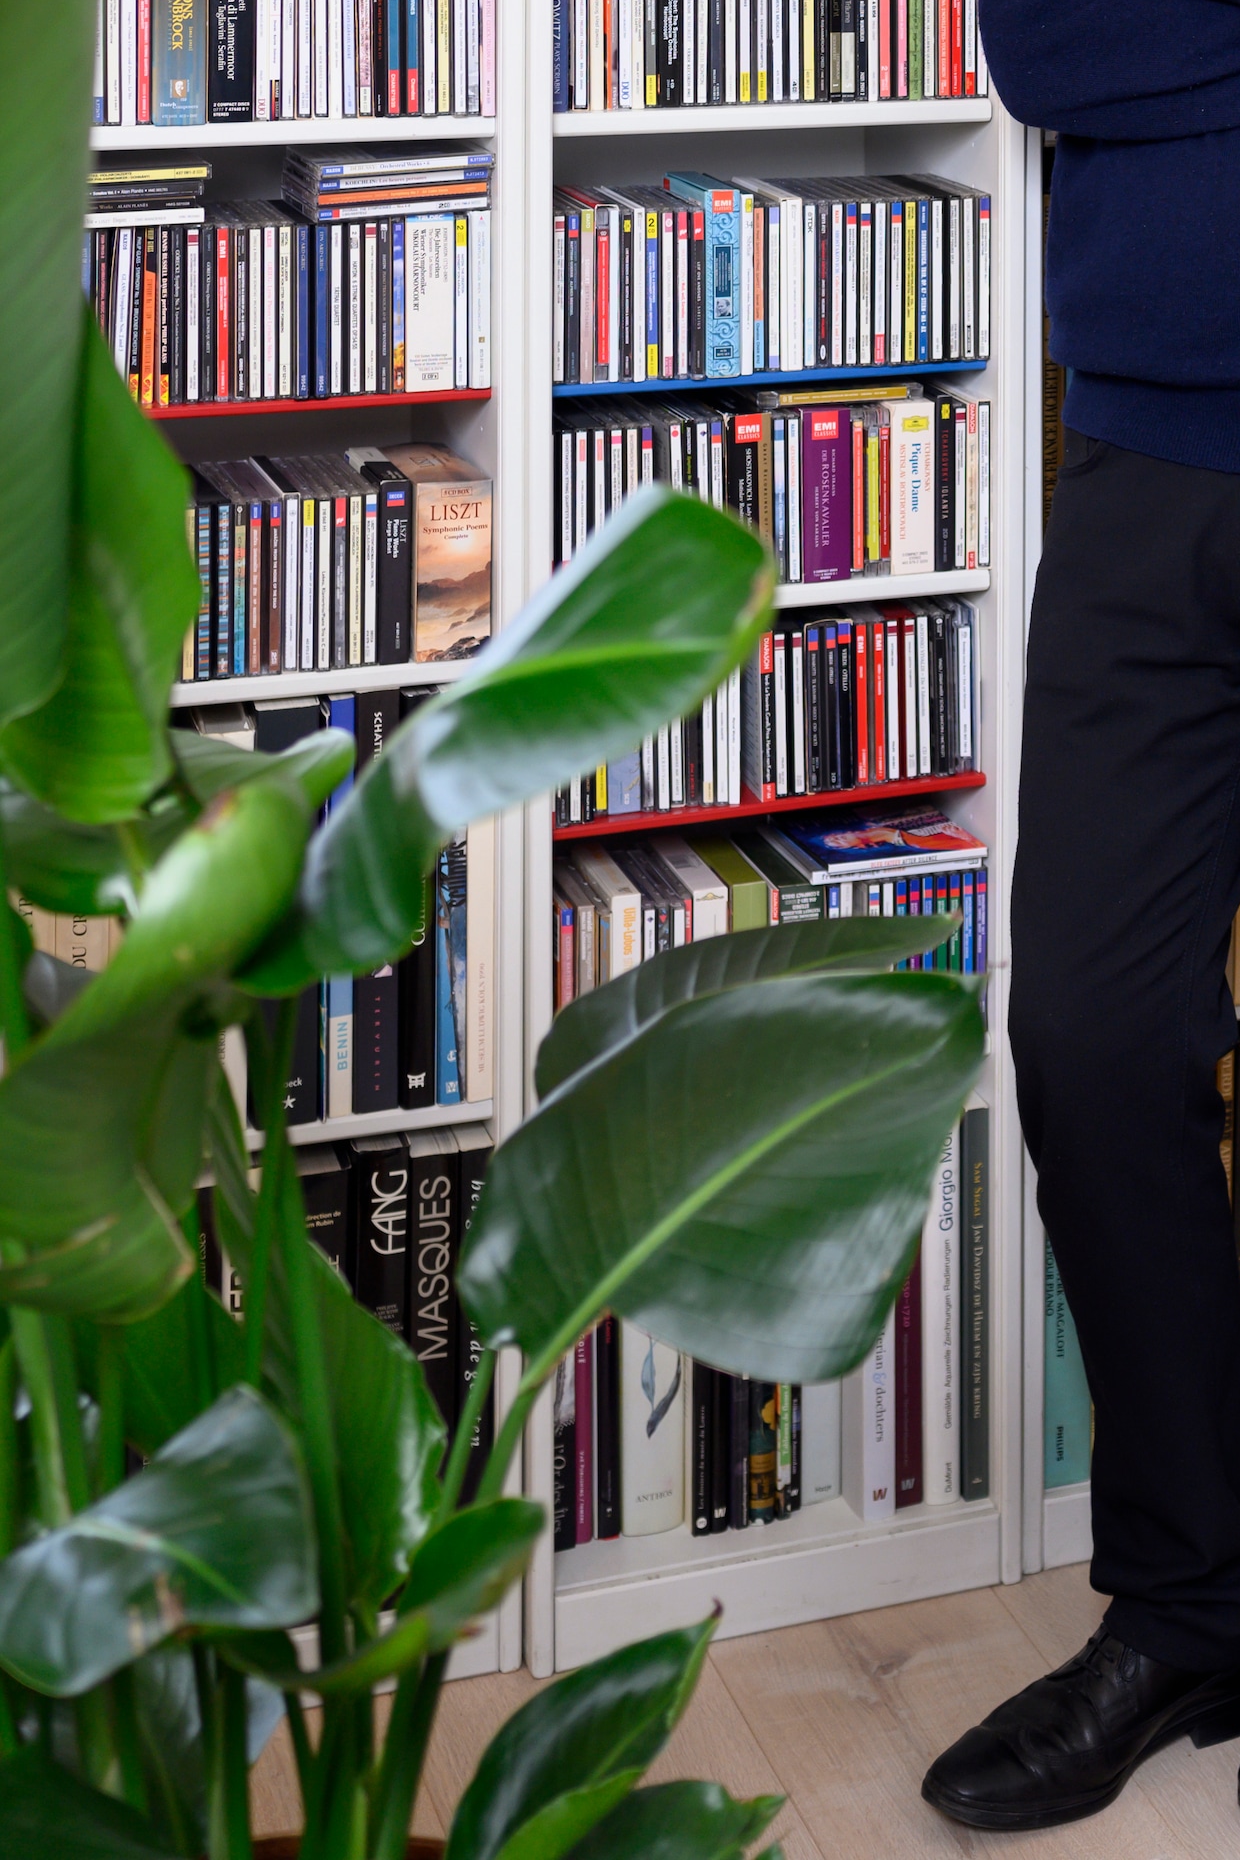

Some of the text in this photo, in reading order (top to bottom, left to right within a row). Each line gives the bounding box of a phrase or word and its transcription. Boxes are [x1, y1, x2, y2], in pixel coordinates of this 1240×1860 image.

[216, 5, 226, 39] Tagliavini
[228, 5, 237, 14] di
[217, 45, 226, 71] Serafin
[227, 17, 236, 80] Lammermoor
[621, 81, 629, 99] DUO
[418, 253, 427, 295] Symphoniker
[814, 423, 836, 431] EMI
[909, 443, 921, 512] Pique Dame
[431, 502, 482, 521] LISZT
[821, 464, 829, 547] ROSENKAVALIER
[423, 525, 464, 534] Symphonic
[336, 1022, 348, 1071] BENIN
[370, 1170, 407, 1255] FANG
[939, 1170, 955, 1231] Giorgio
[417, 1176, 451, 1361] MASQUES
[1055, 1303, 1065, 1358] MAGALOFF
[875, 1388, 886, 1442] dochters
[636, 1489, 672, 1503] ANTHOS
